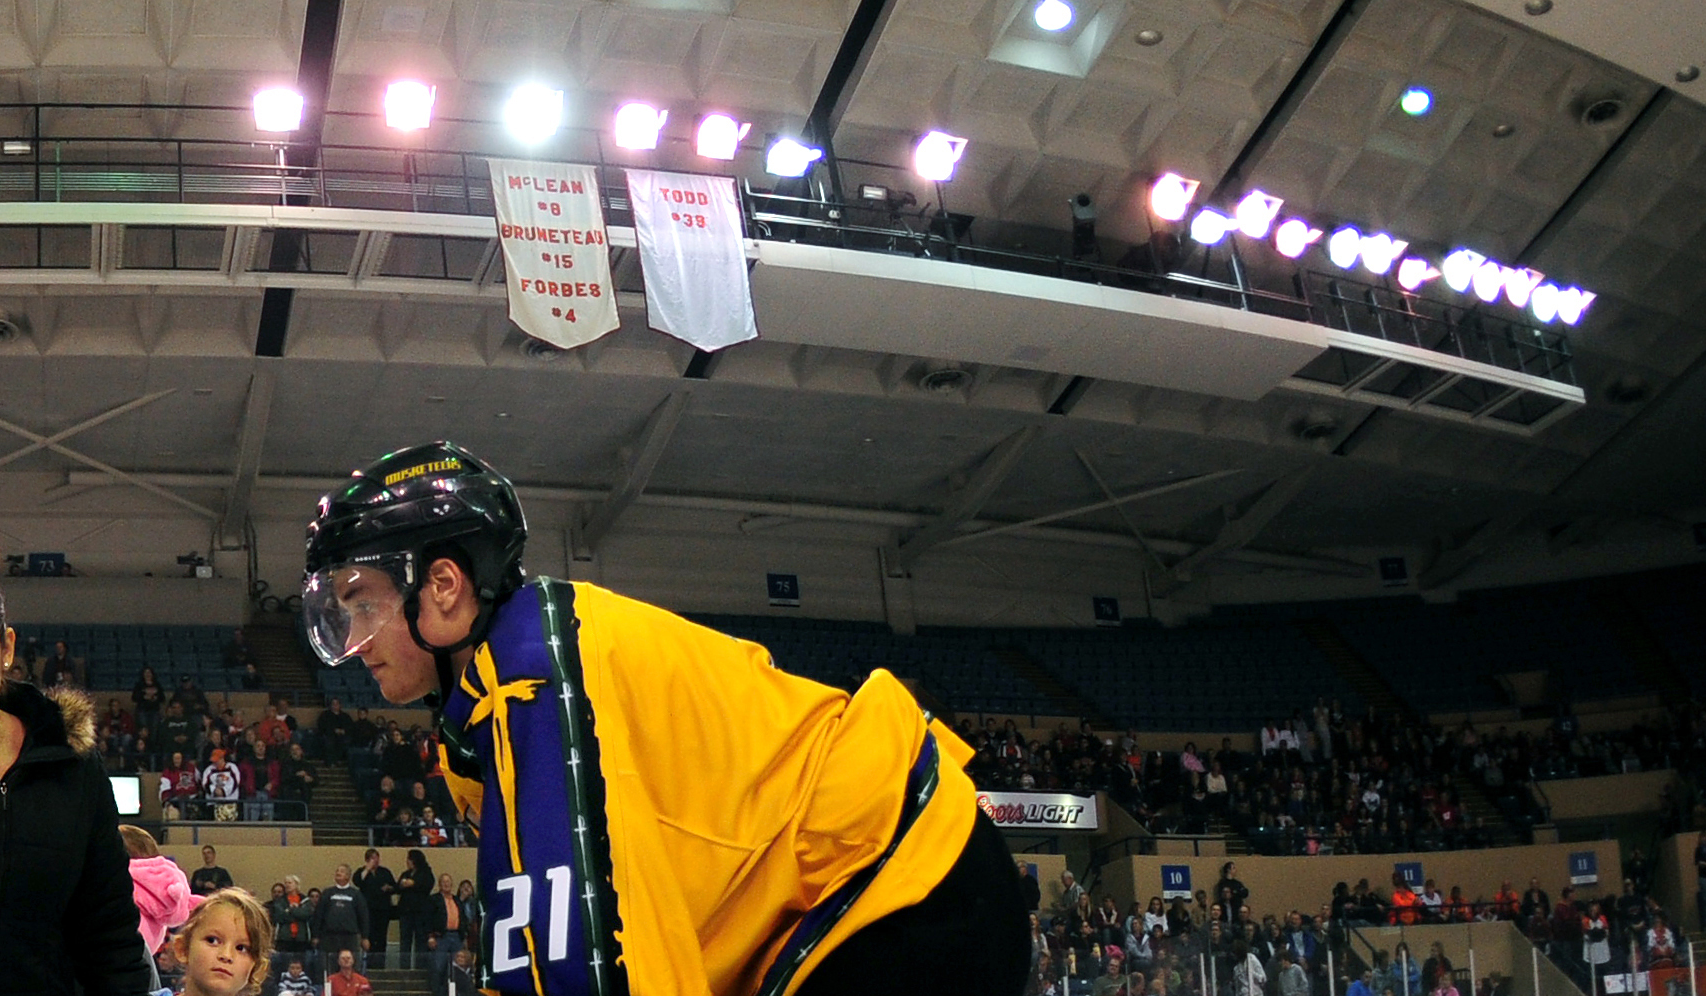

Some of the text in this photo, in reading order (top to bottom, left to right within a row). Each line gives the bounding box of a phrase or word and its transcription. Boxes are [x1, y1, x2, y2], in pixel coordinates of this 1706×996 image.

[659, 188, 709, 206] TODD
[537, 201, 561, 217] #8
[501, 223, 604, 245] BRUNETEAU
[541, 253, 574, 269] #15
[520, 278, 602, 298] FORBES
[550, 307, 577, 323] #4
[39, 560, 56, 572] 73
[775, 581, 790, 592] 75
[1026, 804, 1084, 823] LIGHT
[1577, 858, 1588, 870] 11
[1170, 871, 1183, 885] 10
[1404, 870, 1414, 881] 11
[492, 865, 571, 973] 21
